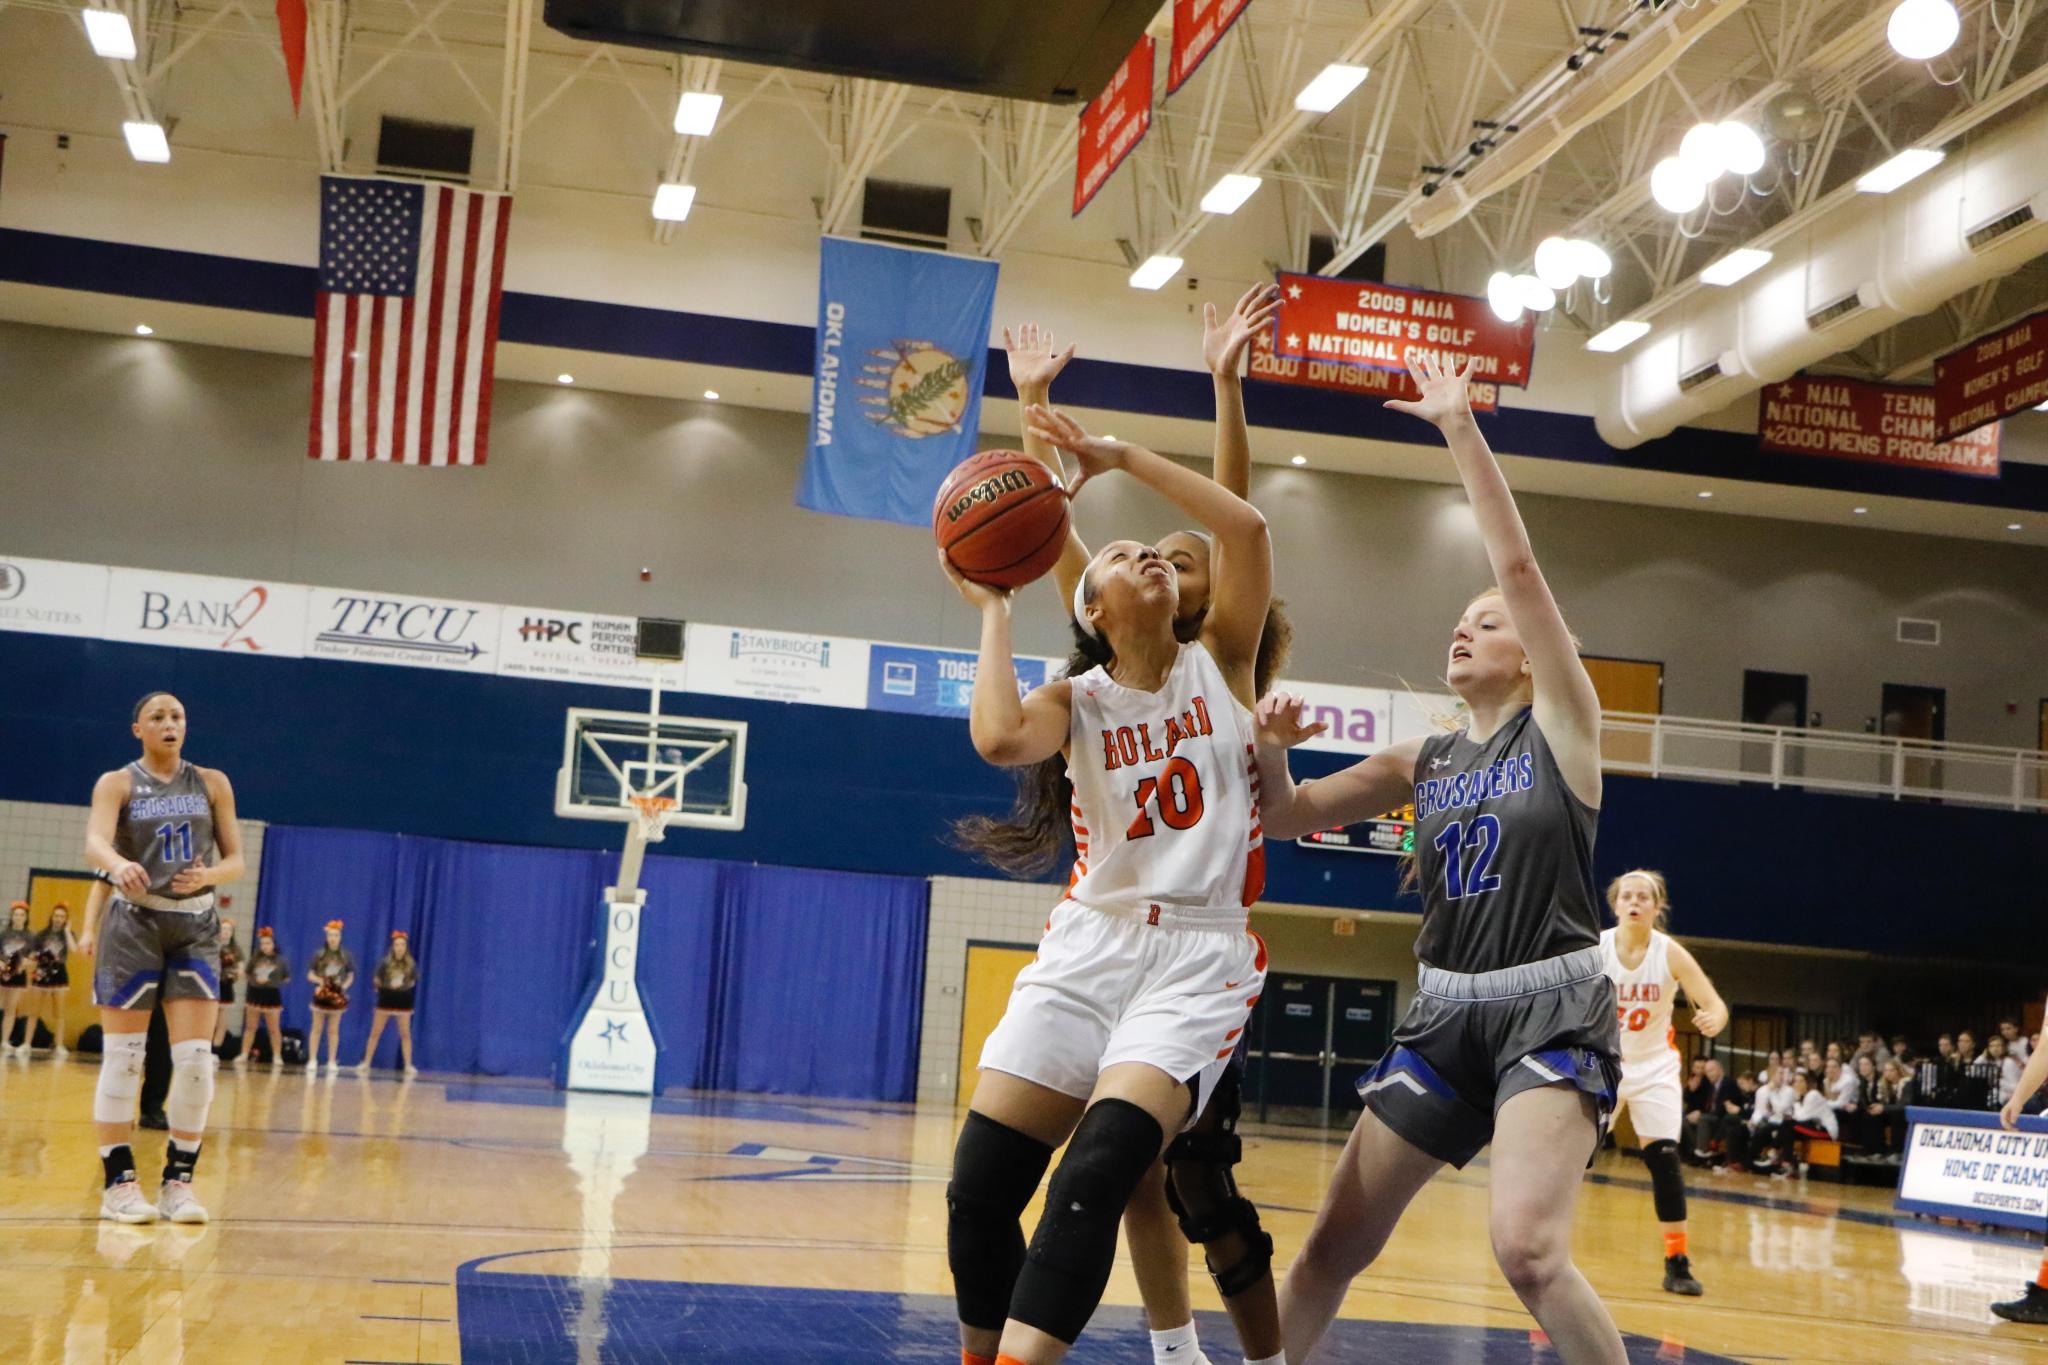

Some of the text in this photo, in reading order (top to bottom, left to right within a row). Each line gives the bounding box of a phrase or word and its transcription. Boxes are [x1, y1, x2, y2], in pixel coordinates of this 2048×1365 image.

[1358, 290, 1454, 320] 2009 NAIA
[1336, 312, 1476, 346] WOMEN'S GOLF
[1308, 333, 1397, 361] NATIONAL
[815, 302, 845, 446] OKLAHOMA
[1251, 352, 1298, 378] 2000
[1308, 361, 1389, 390] DIVISION
[2016, 350, 2044, 376] GOLF
[1807, 384, 1936, 417] NAIA TENN
[1766, 401, 1862, 431] NATIONAL
[1775, 424, 1978, 466] 2000 MENS PROGRAM
[947, 469, 1034, 522] Wilson
[329, 597, 479, 643] TFCU
[519, 617, 582, 644] HPC
[591, 621, 631, 633] HUMAN
[591, 631, 638, 645] PERFOR
[741, 635, 819, 655] STAYBRIDGE
[156, 821, 193, 862] 11
[1434, 813, 1501, 900] 12
[1618, 983, 1660, 1002] LAND
[1919, 1128, 1994, 1152] OKLAHOMA
[1996, 1134, 2032, 1157] CITY
[1943, 1158, 1981, 1179] HOME
[1982, 1163, 2001, 1182] OF
